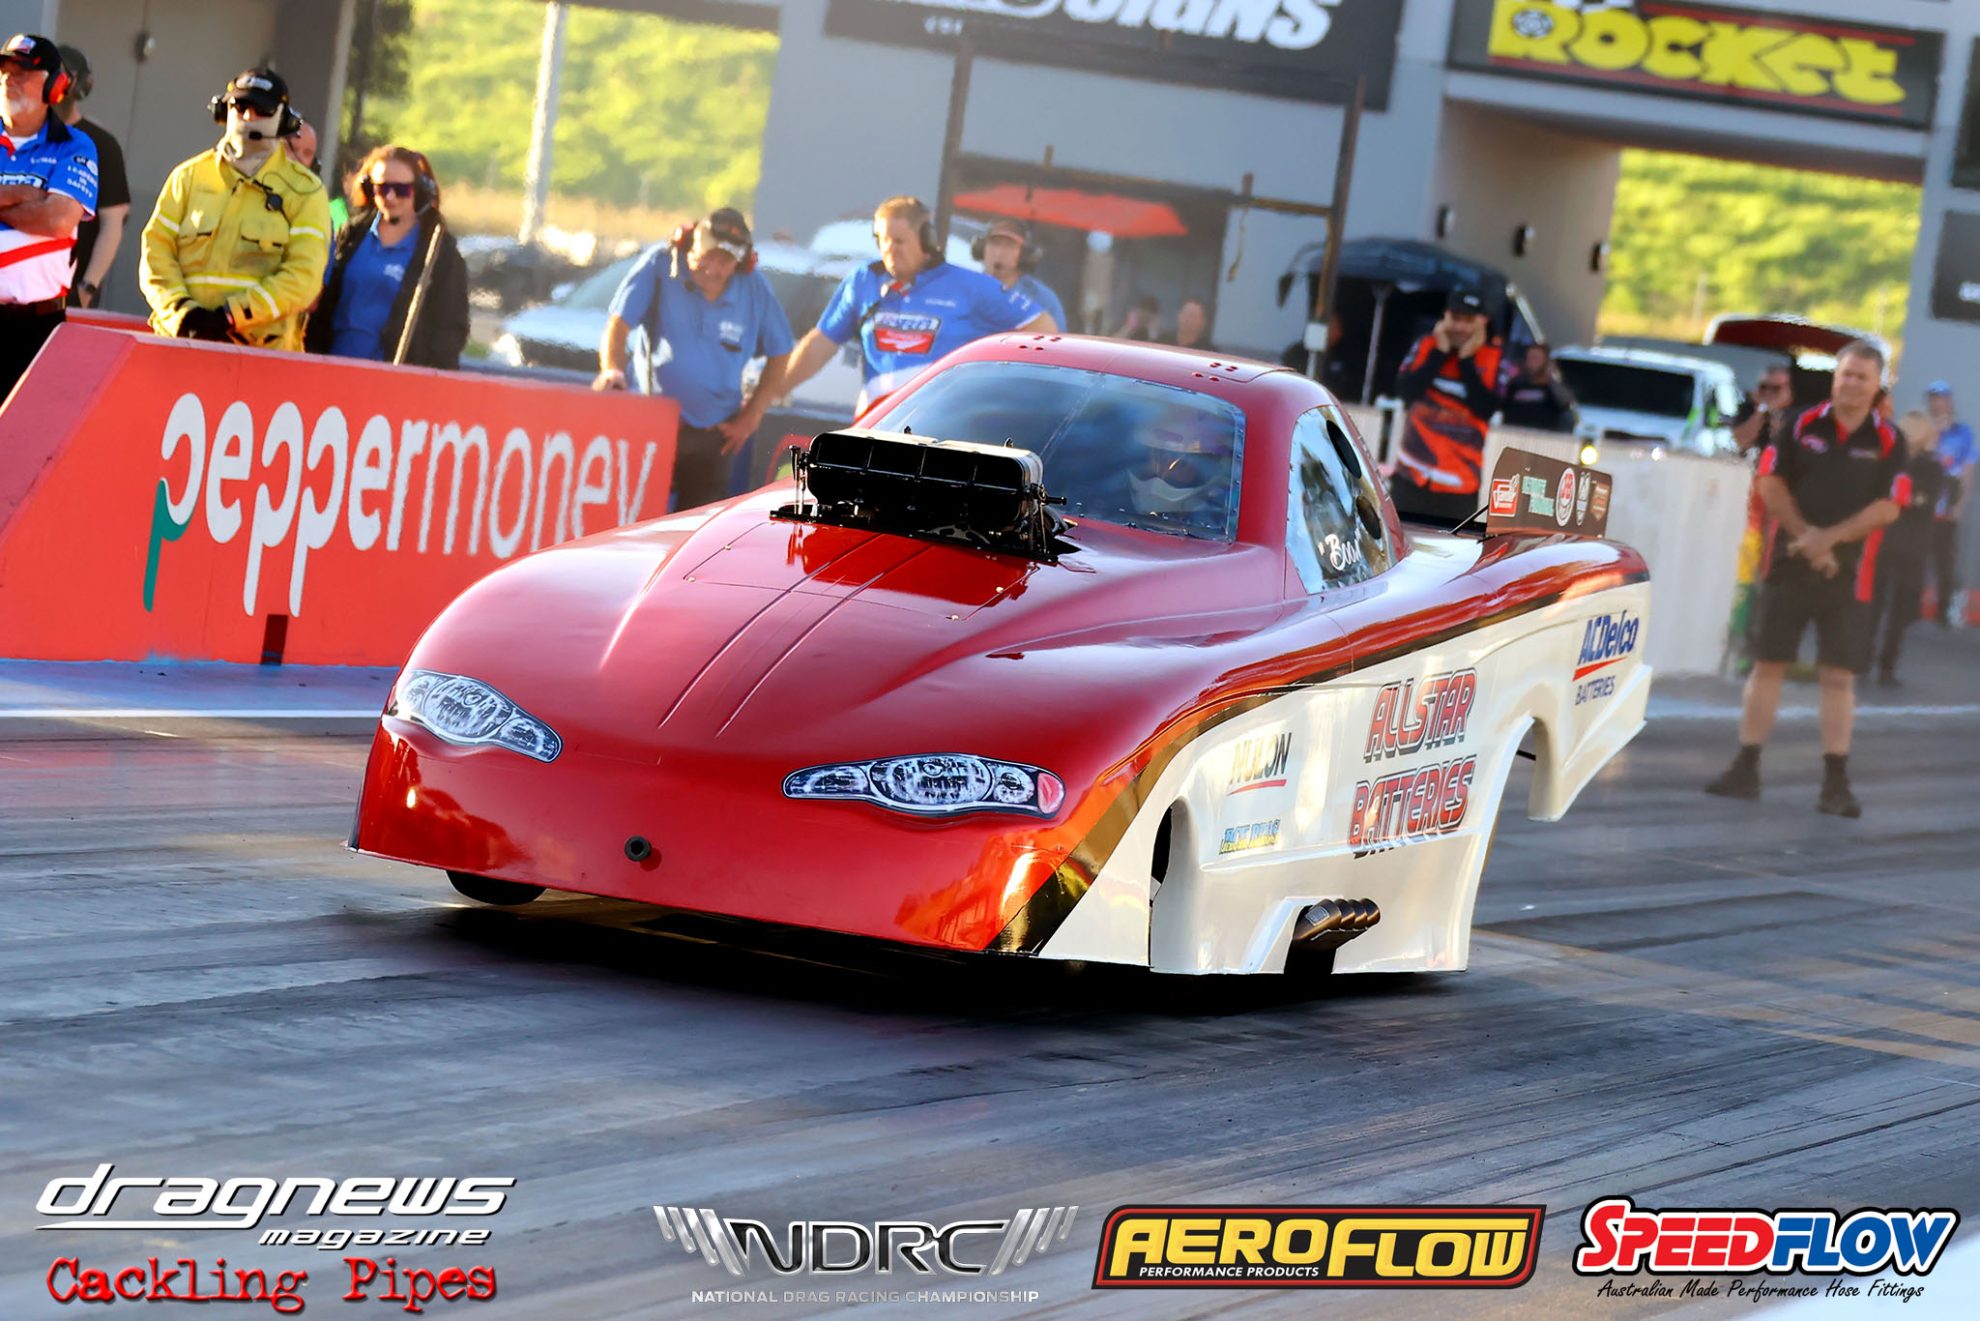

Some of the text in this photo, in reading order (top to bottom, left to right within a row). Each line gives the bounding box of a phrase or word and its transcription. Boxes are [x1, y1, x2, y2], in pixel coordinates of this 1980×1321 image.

[143, 392, 657, 618] peppermoney
[1577, 609, 1640, 666] ACDelco
[1363, 667, 1478, 764] ALLSTAR
[1348, 754, 1478, 859] BATTERIES
